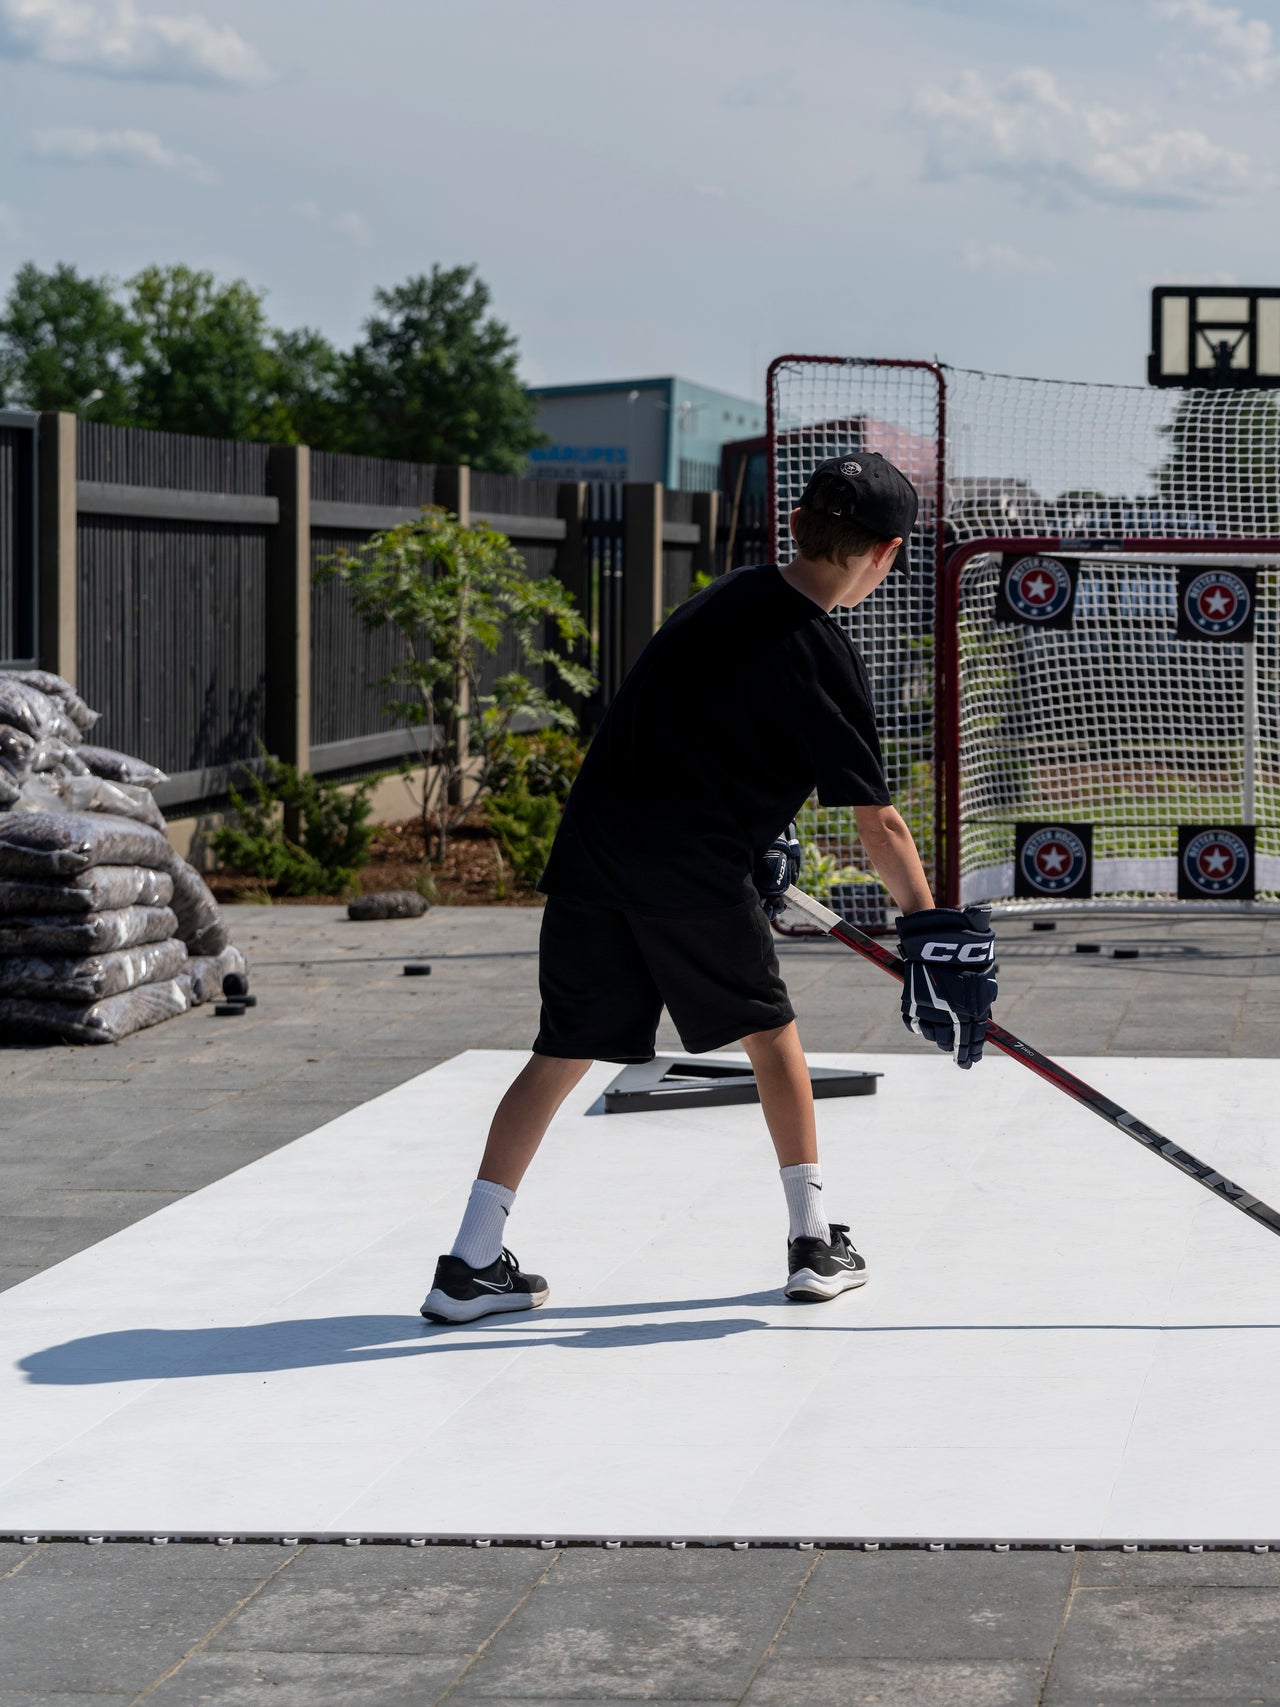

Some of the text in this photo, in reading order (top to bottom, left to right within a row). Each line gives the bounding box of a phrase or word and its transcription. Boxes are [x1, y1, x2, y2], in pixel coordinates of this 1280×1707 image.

[1011, 559, 1067, 588] BETTER HOCKEY
[1189, 573, 1245, 600] BETTER HOCKEY
[1025, 831, 1082, 858] BETTER HOCKEY
[1189, 833, 1244, 858] BETTER HOCKEY
[1115, 1112, 1260, 1209] CCM
